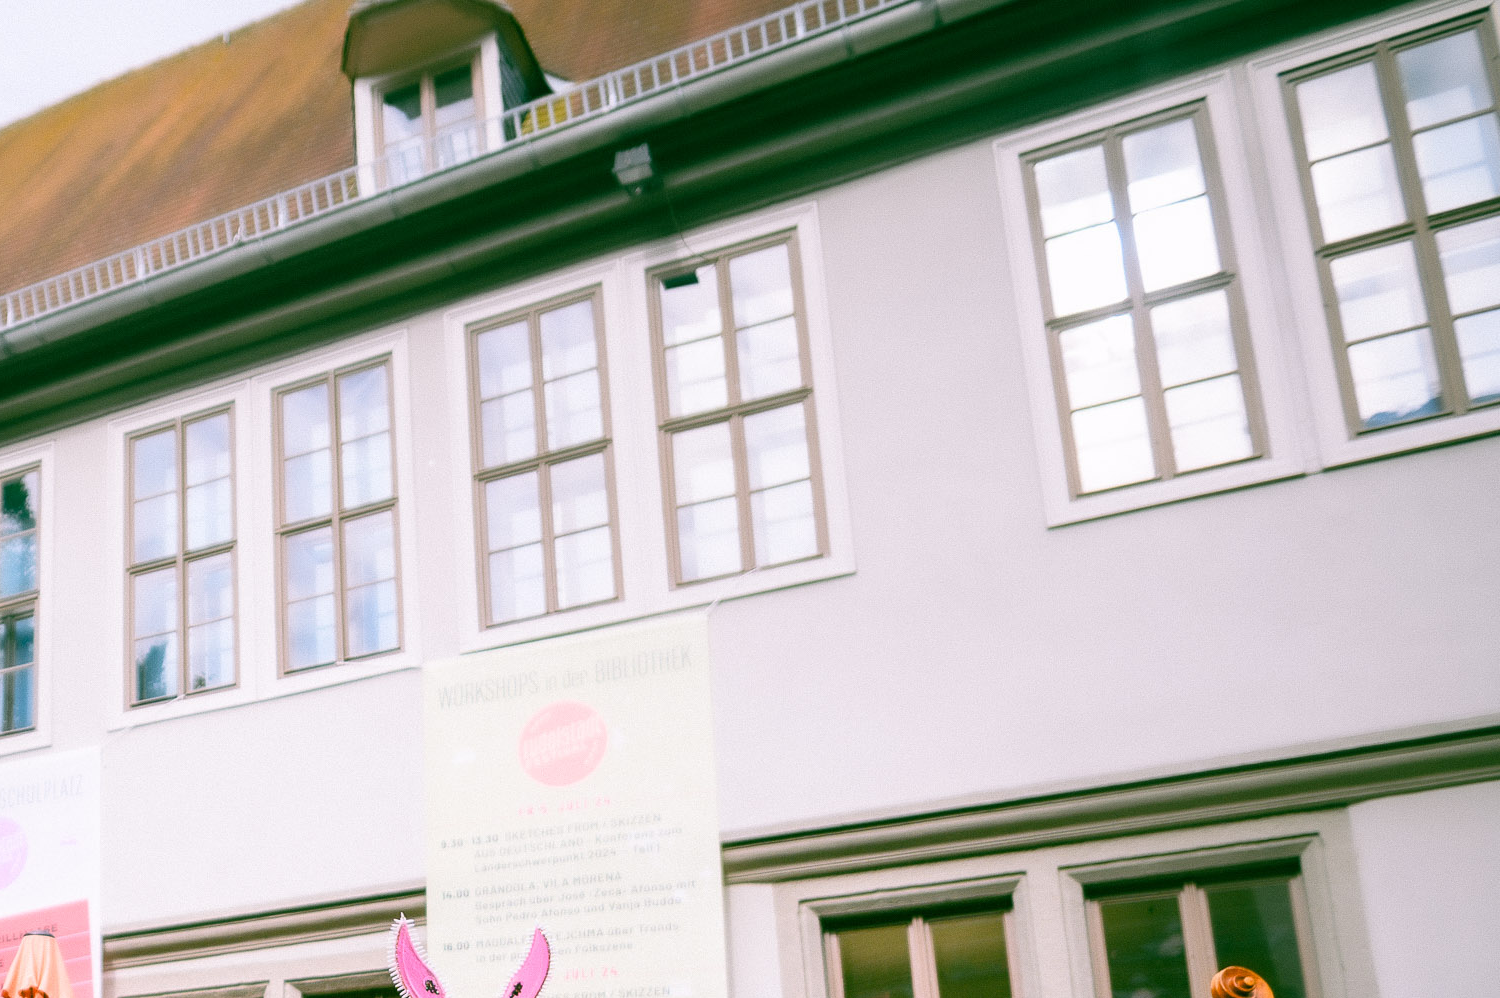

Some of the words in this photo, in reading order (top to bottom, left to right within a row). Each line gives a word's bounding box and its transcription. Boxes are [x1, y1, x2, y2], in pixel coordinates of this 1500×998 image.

[438, 670, 539, 709] WORKSHOPS
[545, 676, 557, 690] in
[563, 669, 588, 689] der
[594, 645, 692, 683] BIBLIOTHEK
[0, 774, 84, 809] SCHULPLATZ
[505, 825, 564, 842] SKETCHES
[567, 821, 599, 833] FROM
[610, 813, 662, 829] SKIZZEN
[499, 837, 583, 857] DEUTSCHLAND
[588, 847, 617, 859] 2024
[442, 888, 470, 900] 14.00
[572, 872, 622, 886] MORENA
[631, 883, 672, 894] Afonso
[676, 880, 696, 889] mit
[505, 911, 537, 922] Pedro
[639, 922, 679, 933] Trends
